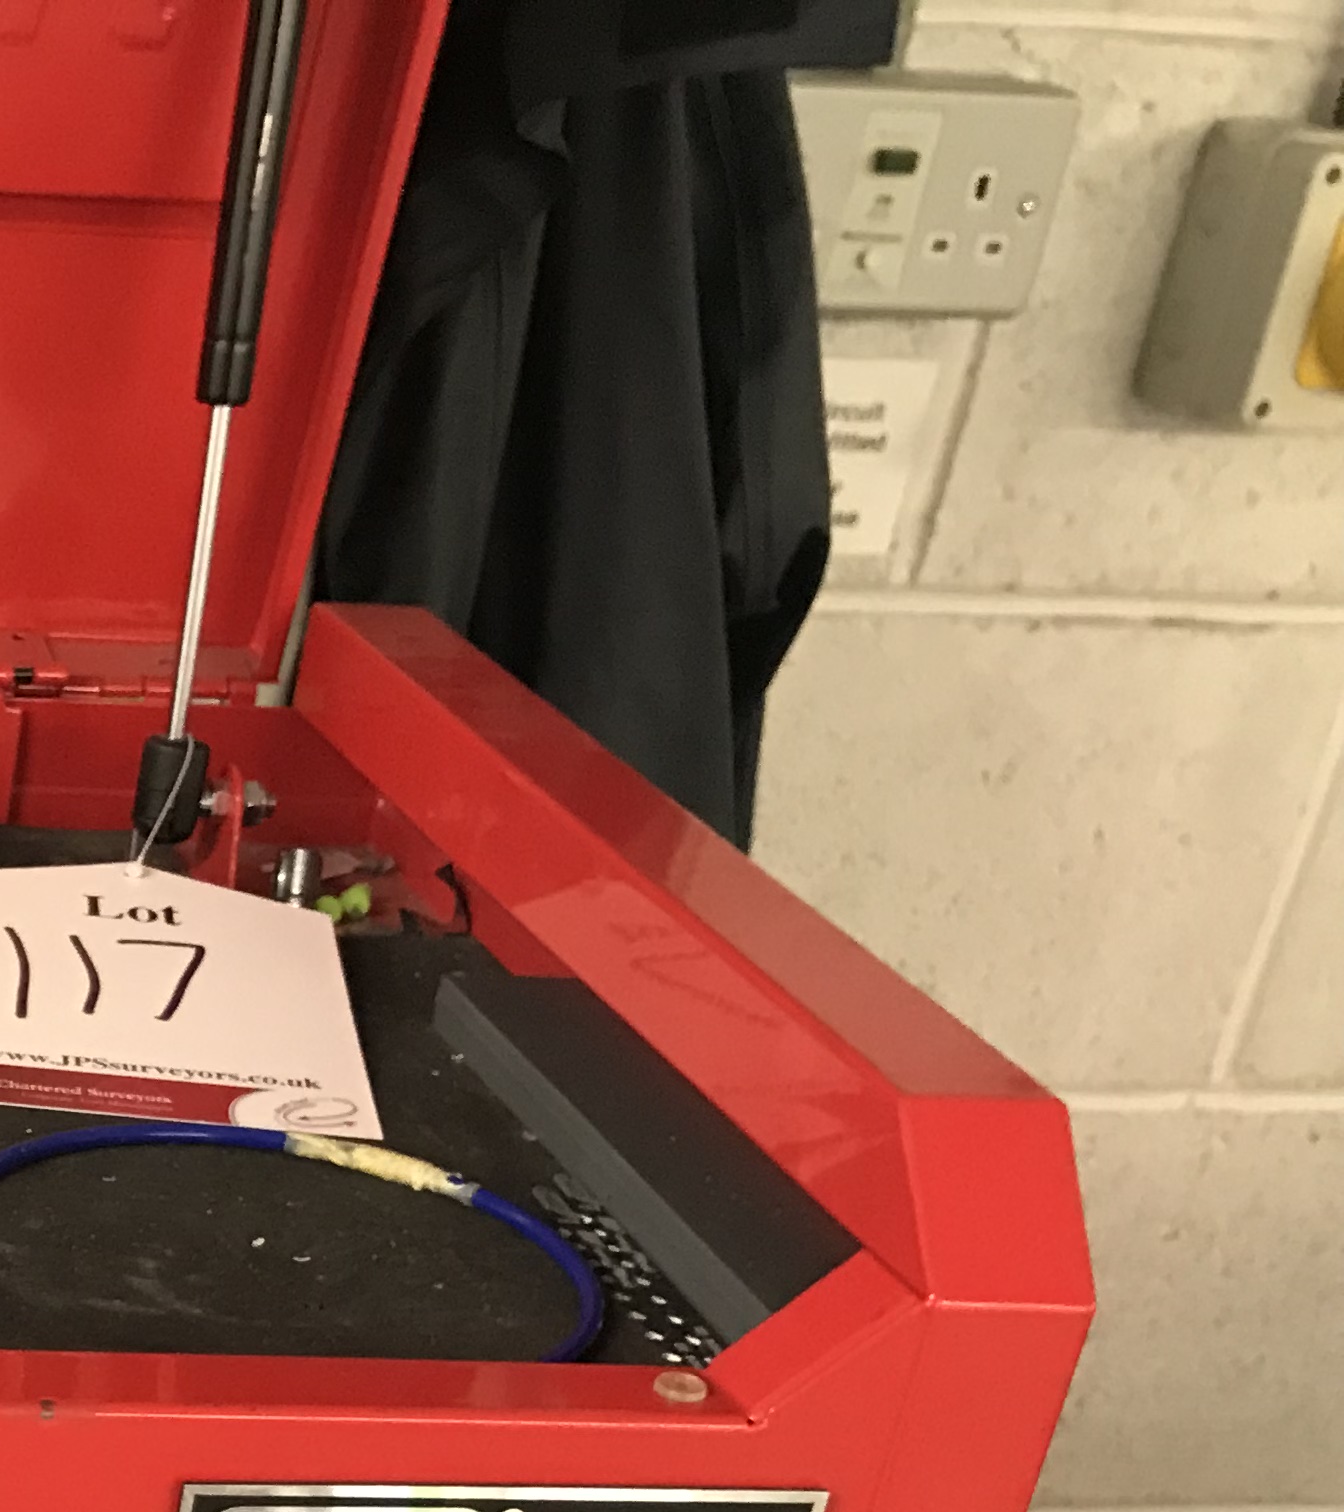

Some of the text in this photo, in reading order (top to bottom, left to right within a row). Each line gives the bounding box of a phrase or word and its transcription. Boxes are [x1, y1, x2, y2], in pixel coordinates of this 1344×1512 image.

[83, 893, 182, 926] Lot
[3, 926, 206, 1021] 117
[87, 1086, 173, 1105] Surveyors
